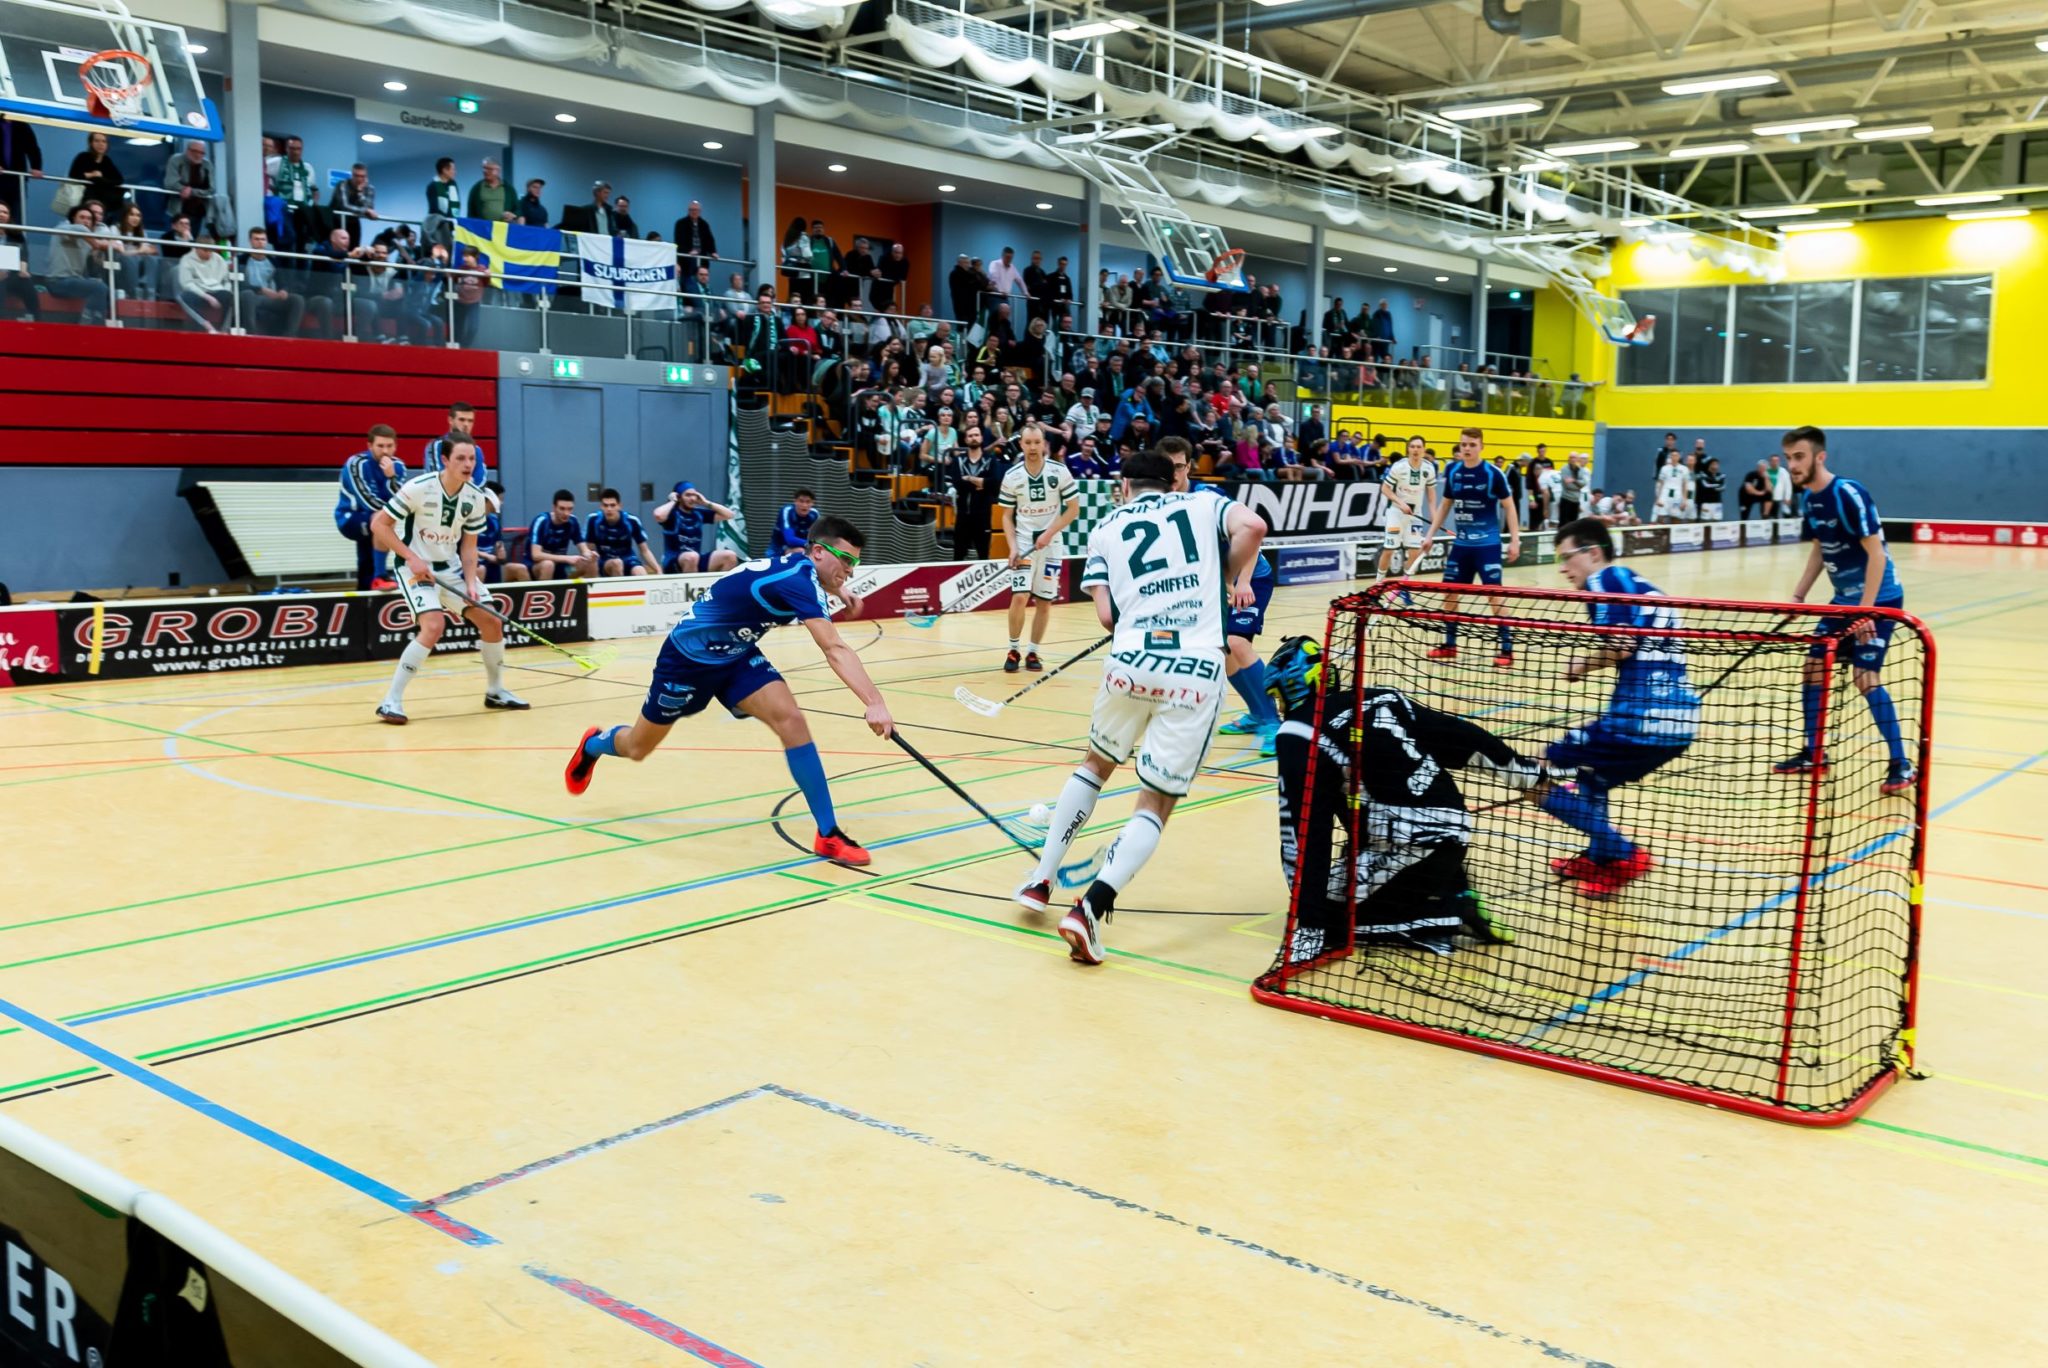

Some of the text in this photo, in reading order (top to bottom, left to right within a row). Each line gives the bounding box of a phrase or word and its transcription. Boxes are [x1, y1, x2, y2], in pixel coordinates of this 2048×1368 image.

[400, 111, 465, 133] Garderobe
[1030, 487, 1045, 499] 62
[443, 509, 451, 523] 2
[1121, 509, 1200, 580] 21
[1936, 531, 1990, 544] Sparkasse
[852, 577, 877, 595] SIGN
[1013, 576, 1026, 588] 62
[1139, 574, 1199, 598] SCHIFFER
[378, 589, 576, 631] GBI
[415, 595, 425, 608] 2
[74, 603, 349, 649] GROBI
[114, 637, 349, 660] GROSSBILDSPEZIALISTEN
[152, 653, 285, 672] www.grobi.tv
[1061, 809, 1087, 845] UNIHOC
